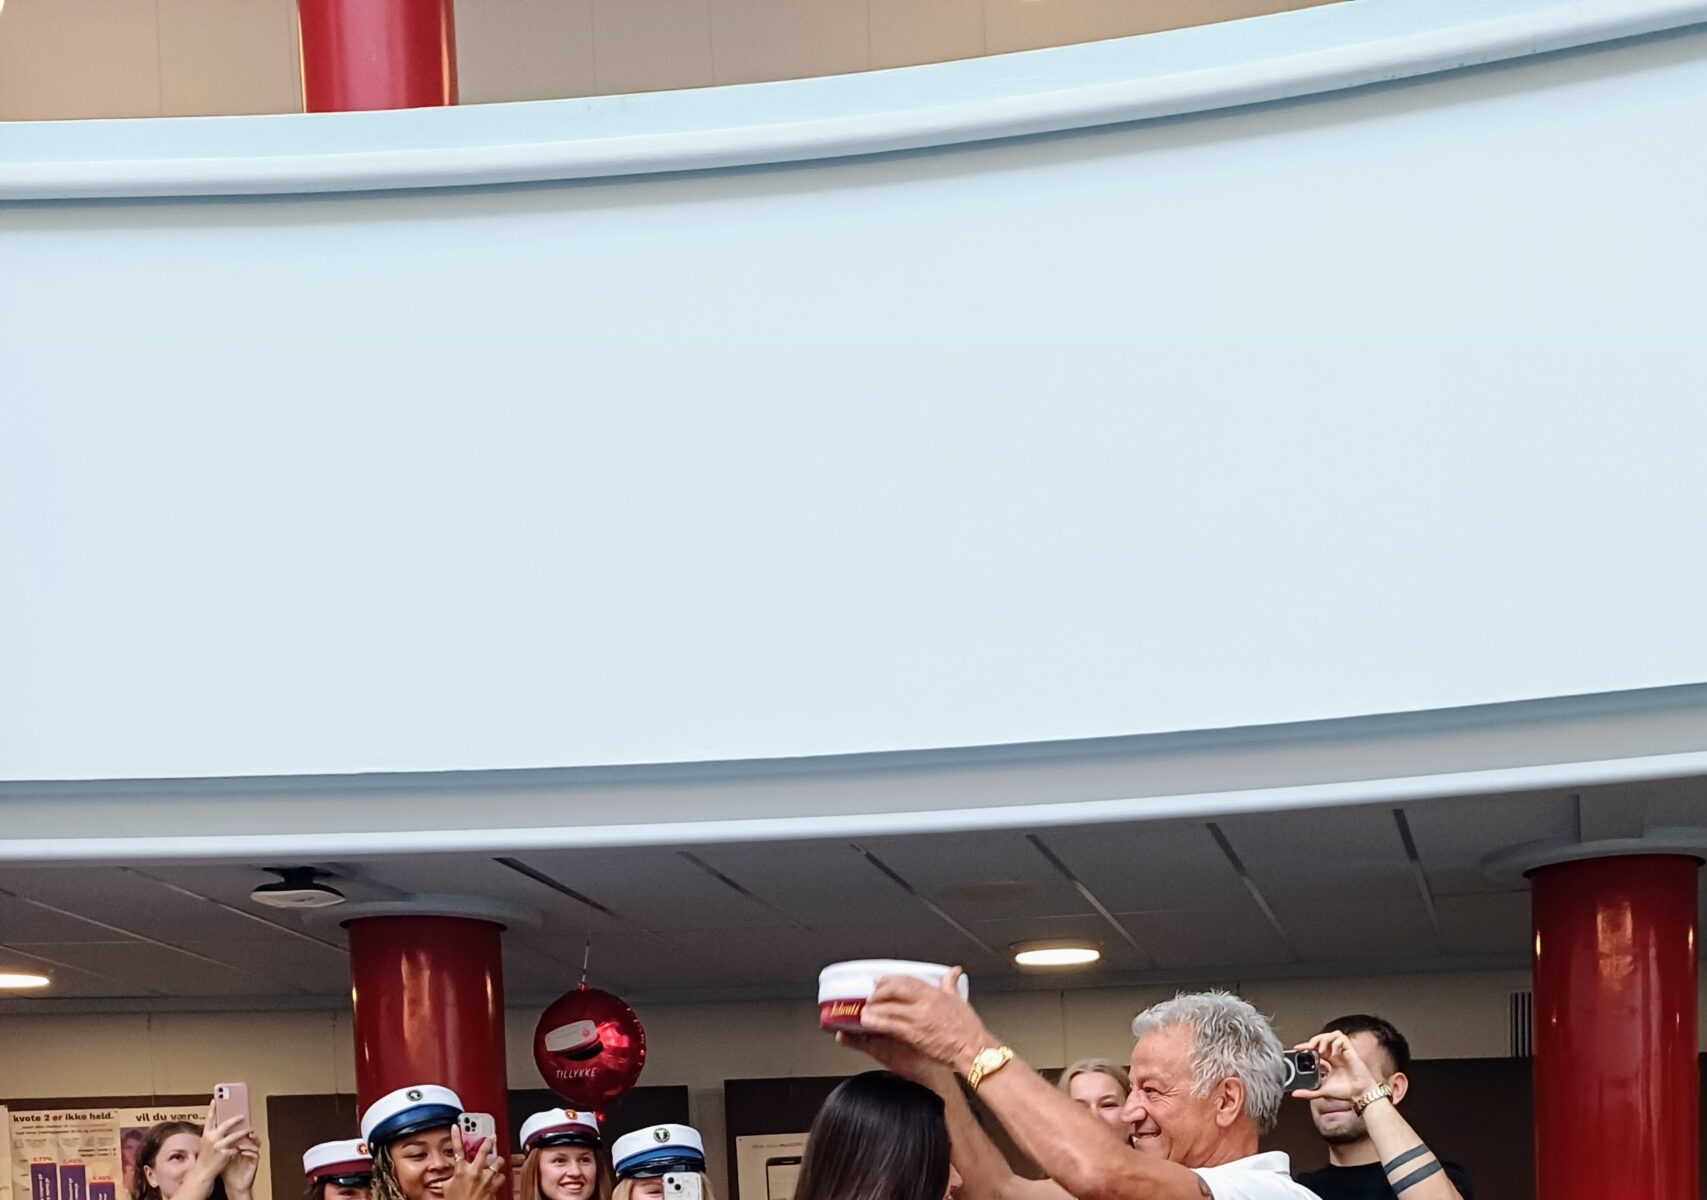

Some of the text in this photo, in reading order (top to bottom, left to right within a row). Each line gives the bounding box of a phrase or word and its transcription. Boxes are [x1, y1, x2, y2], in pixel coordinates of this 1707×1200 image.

[556, 1068, 597, 1079] TILLYKKE
[13, 1114, 41, 1122] kvote
[135, 1113, 150, 1121] vil
[152, 1113, 167, 1121] du
